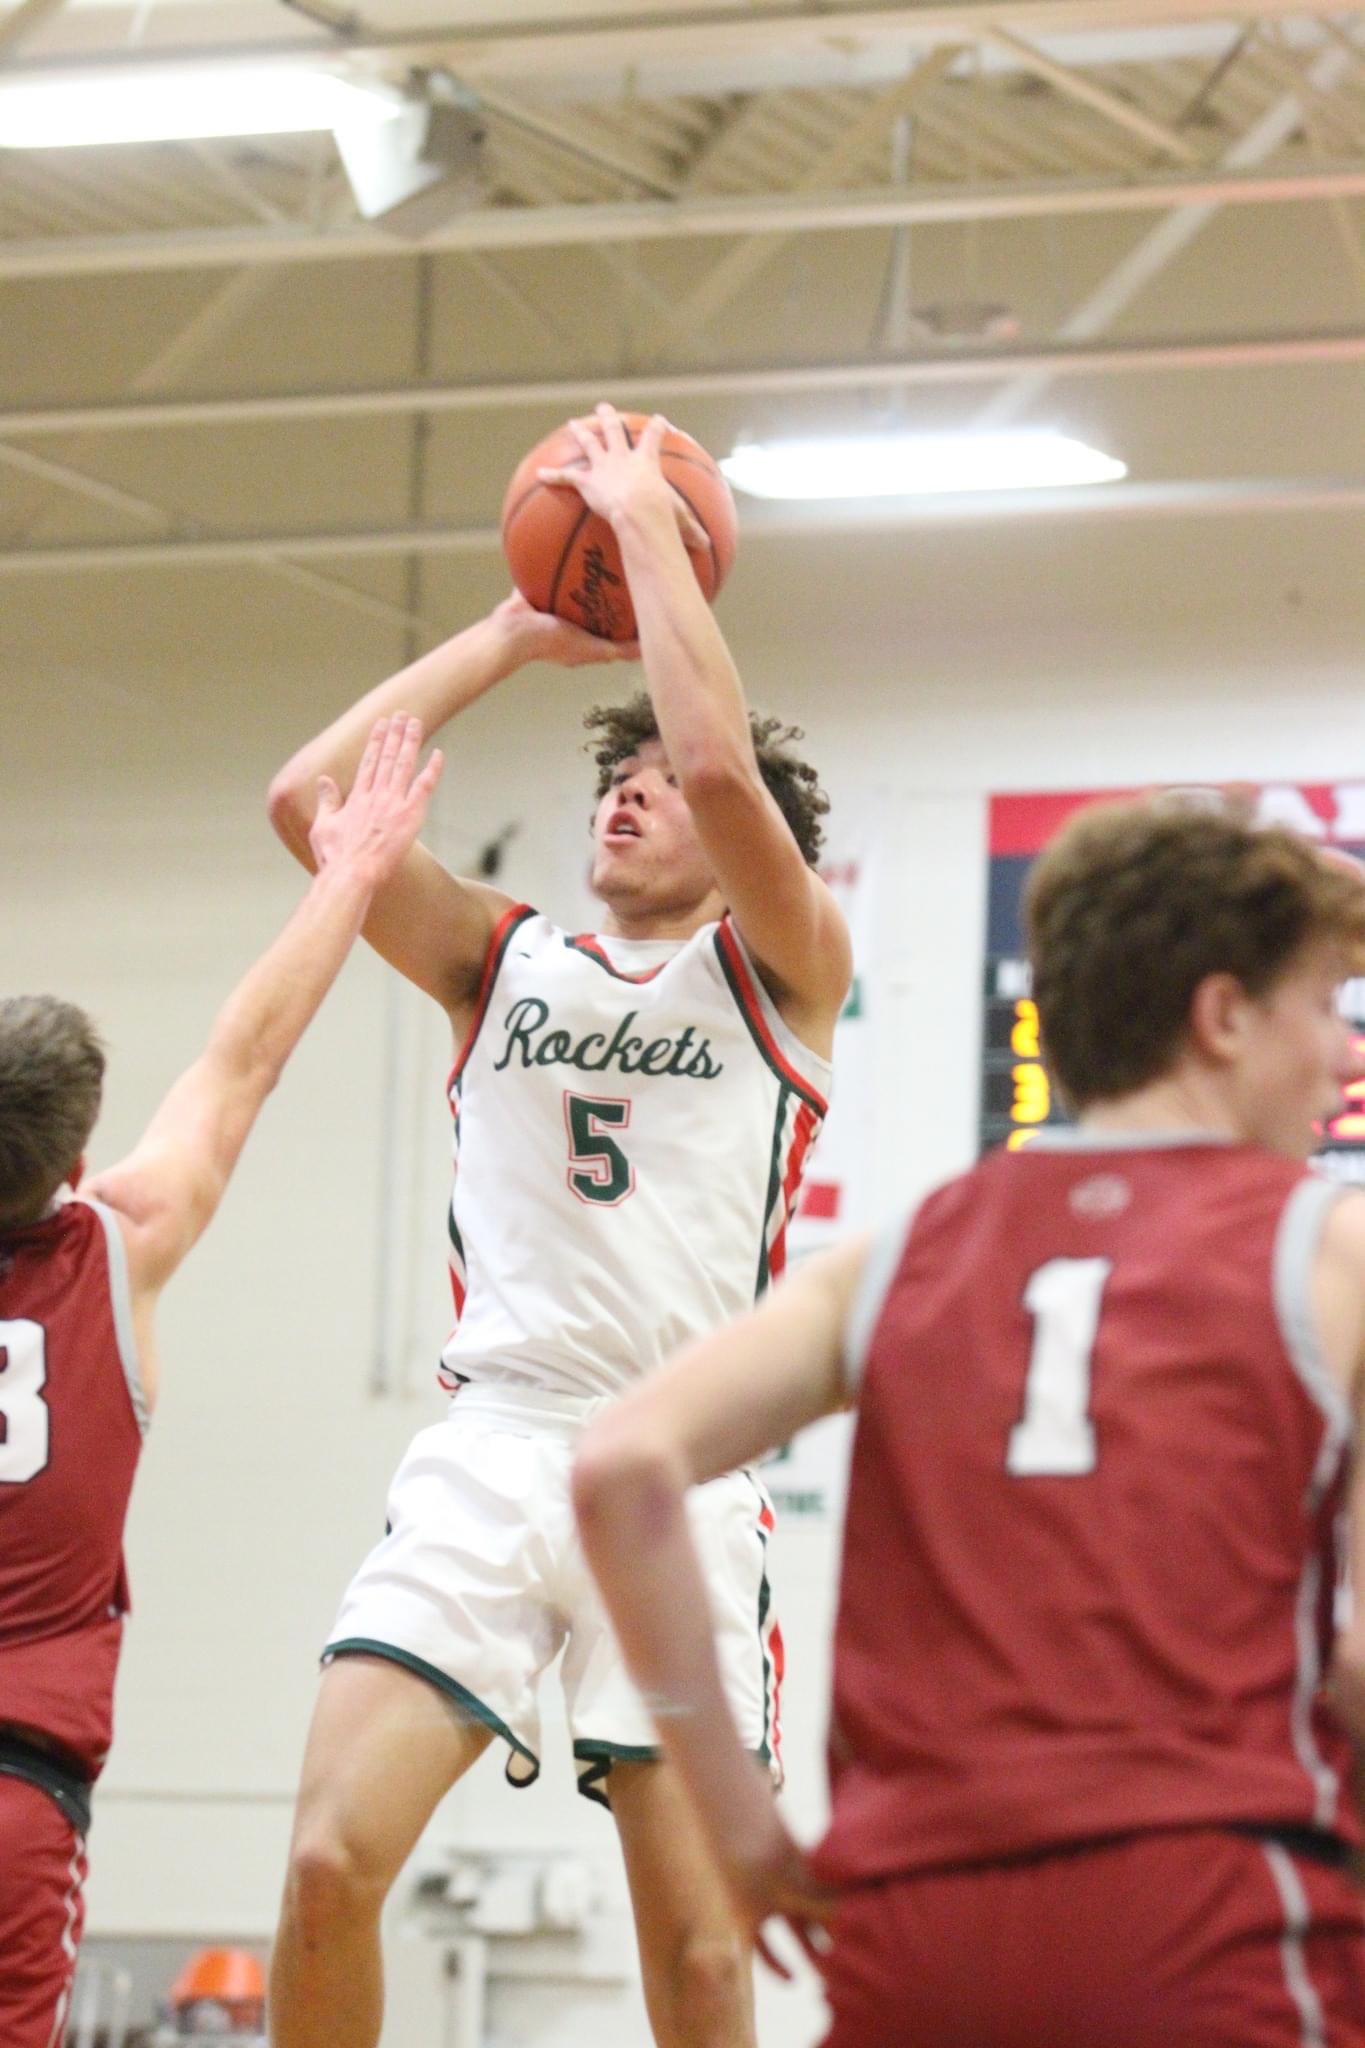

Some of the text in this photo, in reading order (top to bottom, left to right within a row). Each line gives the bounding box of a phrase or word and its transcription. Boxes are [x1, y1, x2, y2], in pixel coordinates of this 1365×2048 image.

[494, 998, 723, 1080] Rockets
[563, 1089, 636, 1207] 5
[1005, 1255, 1112, 1476] 1
